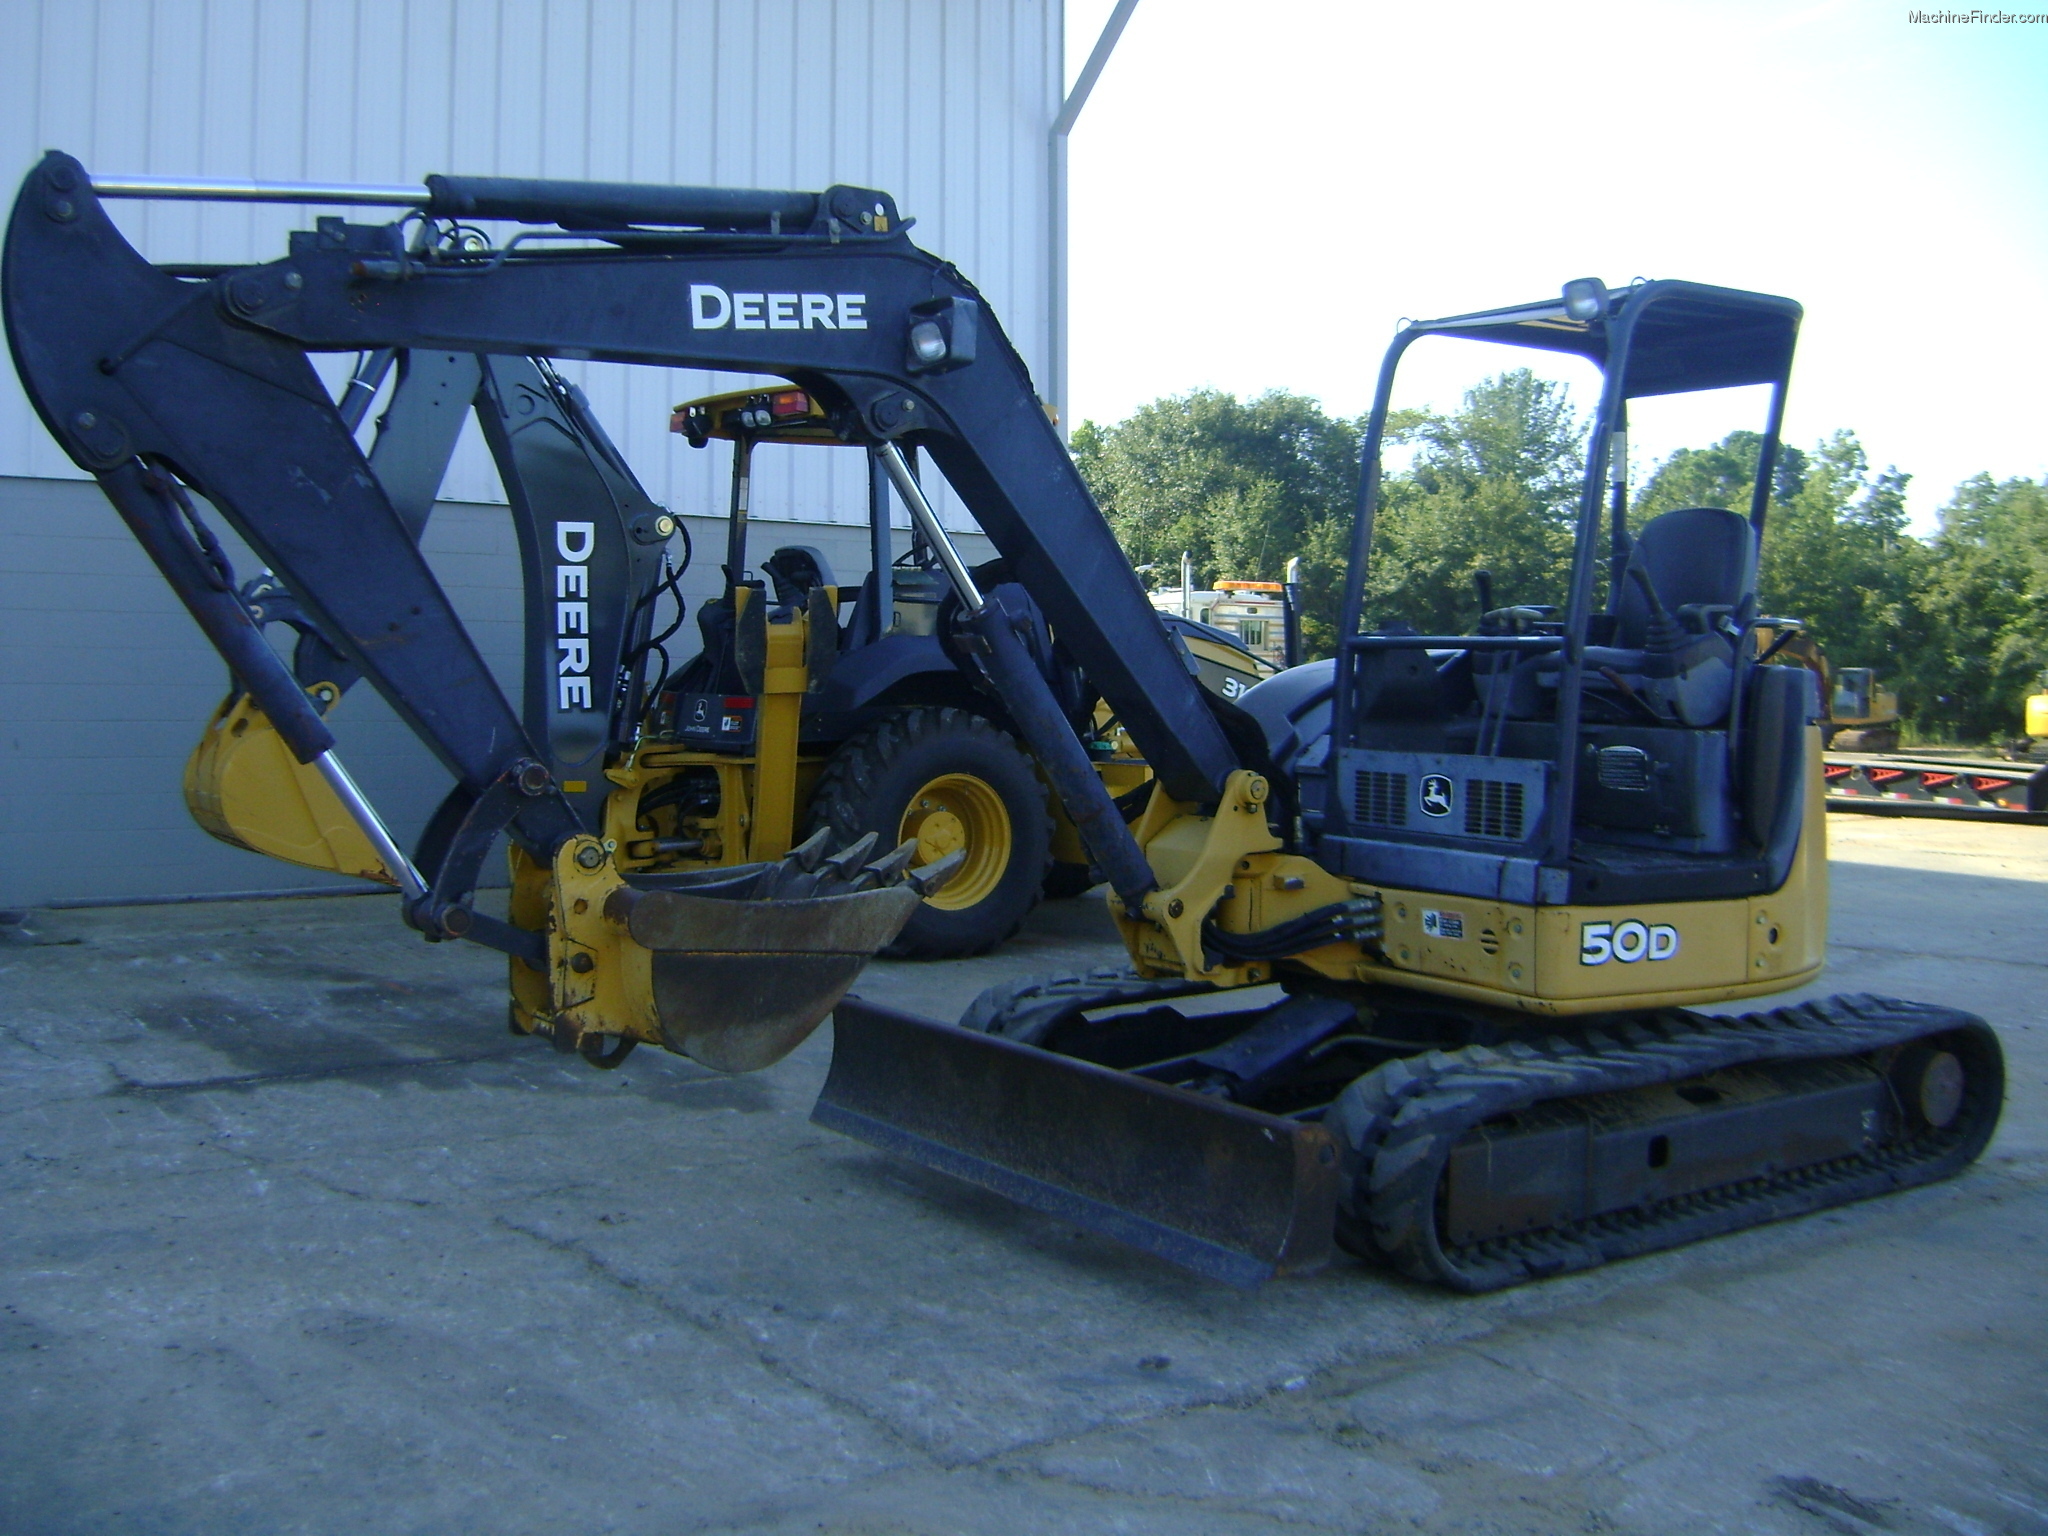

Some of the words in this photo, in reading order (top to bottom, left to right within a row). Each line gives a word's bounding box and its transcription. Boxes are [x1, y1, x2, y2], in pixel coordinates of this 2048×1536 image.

[690, 284, 868, 330] DEERE
[556, 521, 595, 709] DEERE
[1580, 919, 1679, 966] 50D
